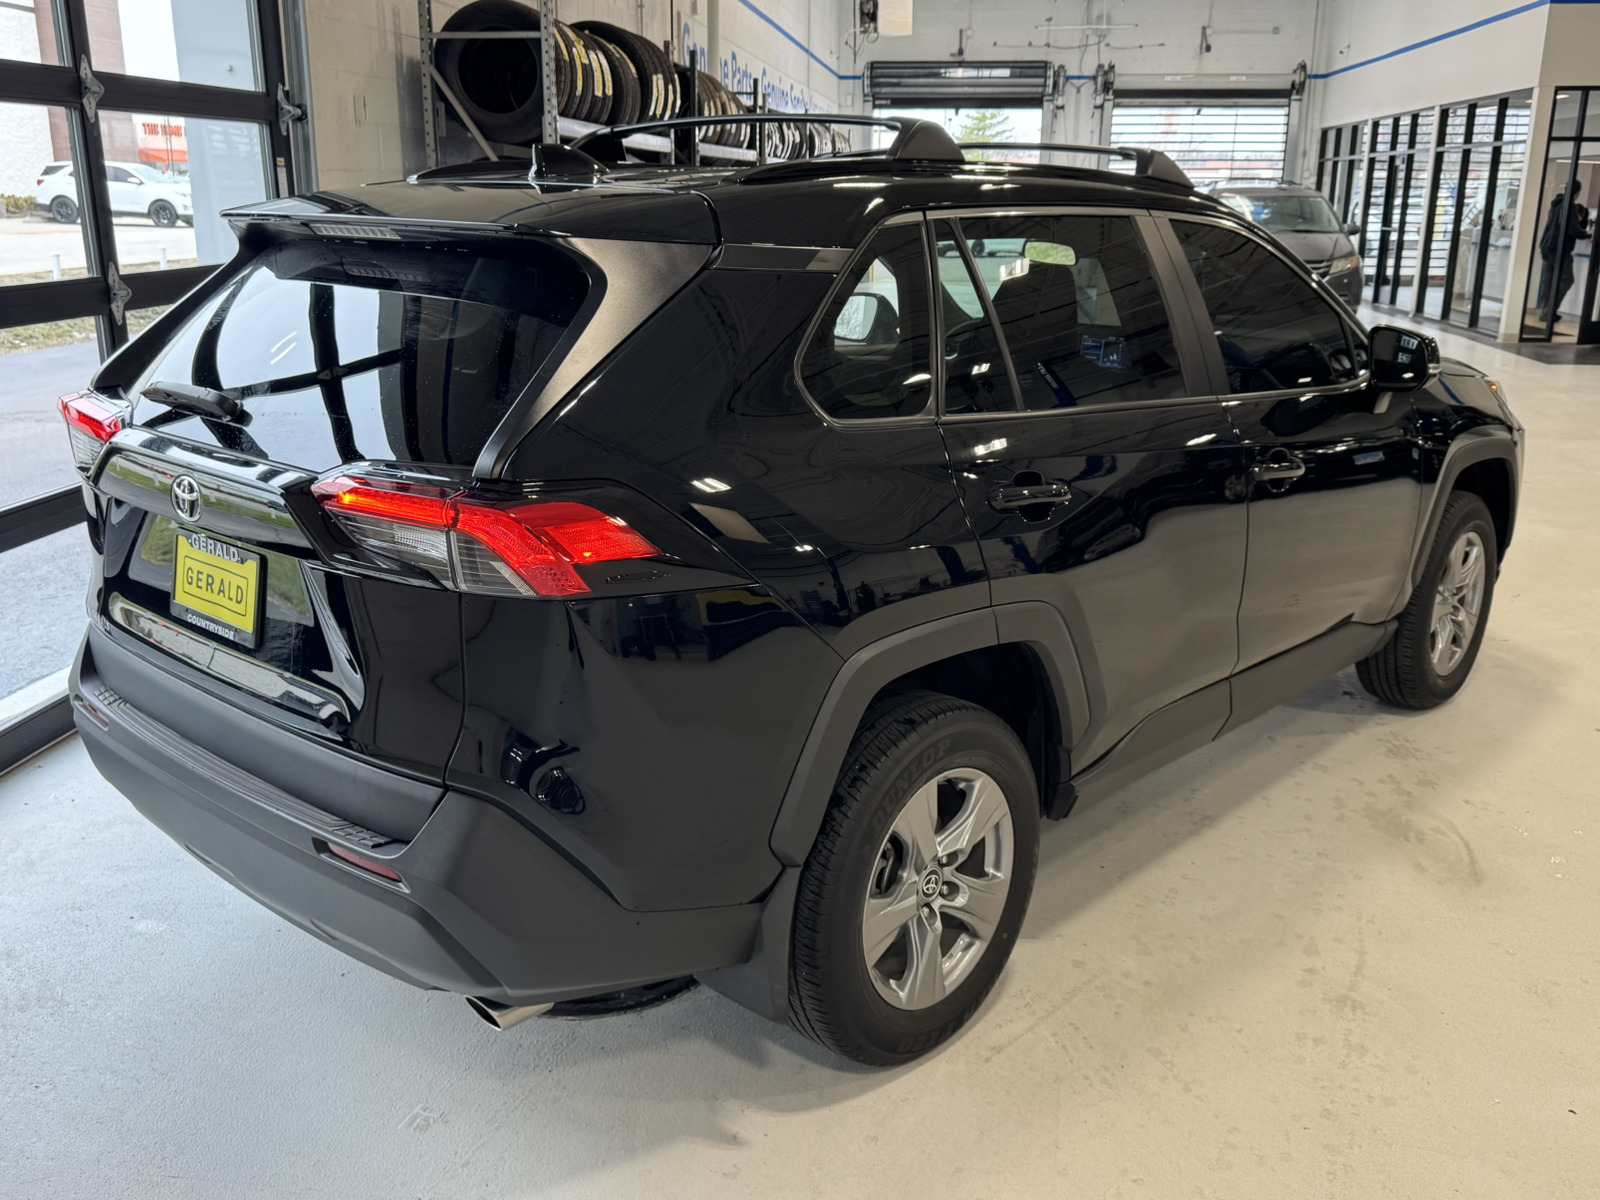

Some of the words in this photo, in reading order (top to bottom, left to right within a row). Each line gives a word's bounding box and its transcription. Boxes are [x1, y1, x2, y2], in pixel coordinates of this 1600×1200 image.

[191, 533, 239, 562] GERALD
[185, 566, 244, 605] GERALD
[187, 613, 235, 640] COUNTRYSIDE
[871, 738, 951, 832] DUNLOP
